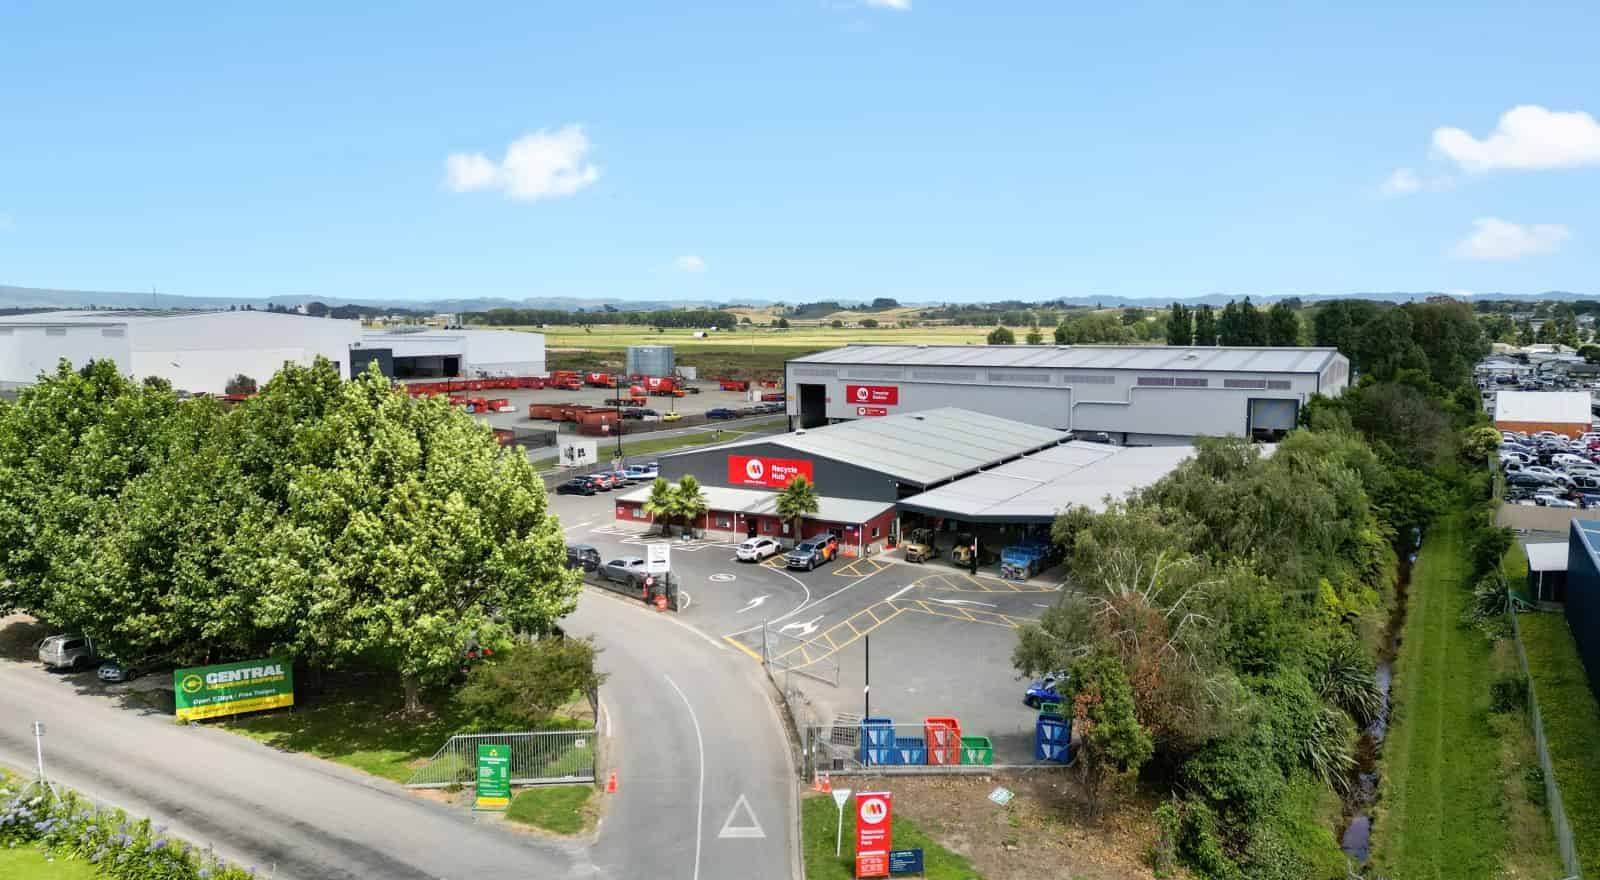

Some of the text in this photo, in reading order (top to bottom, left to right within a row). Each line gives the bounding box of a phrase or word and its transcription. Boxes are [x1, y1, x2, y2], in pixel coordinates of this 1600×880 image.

[771, 464, 798, 474] Recycle
[771, 471, 786, 480] Hub
[206, 664, 285, 684] CENTRAL
